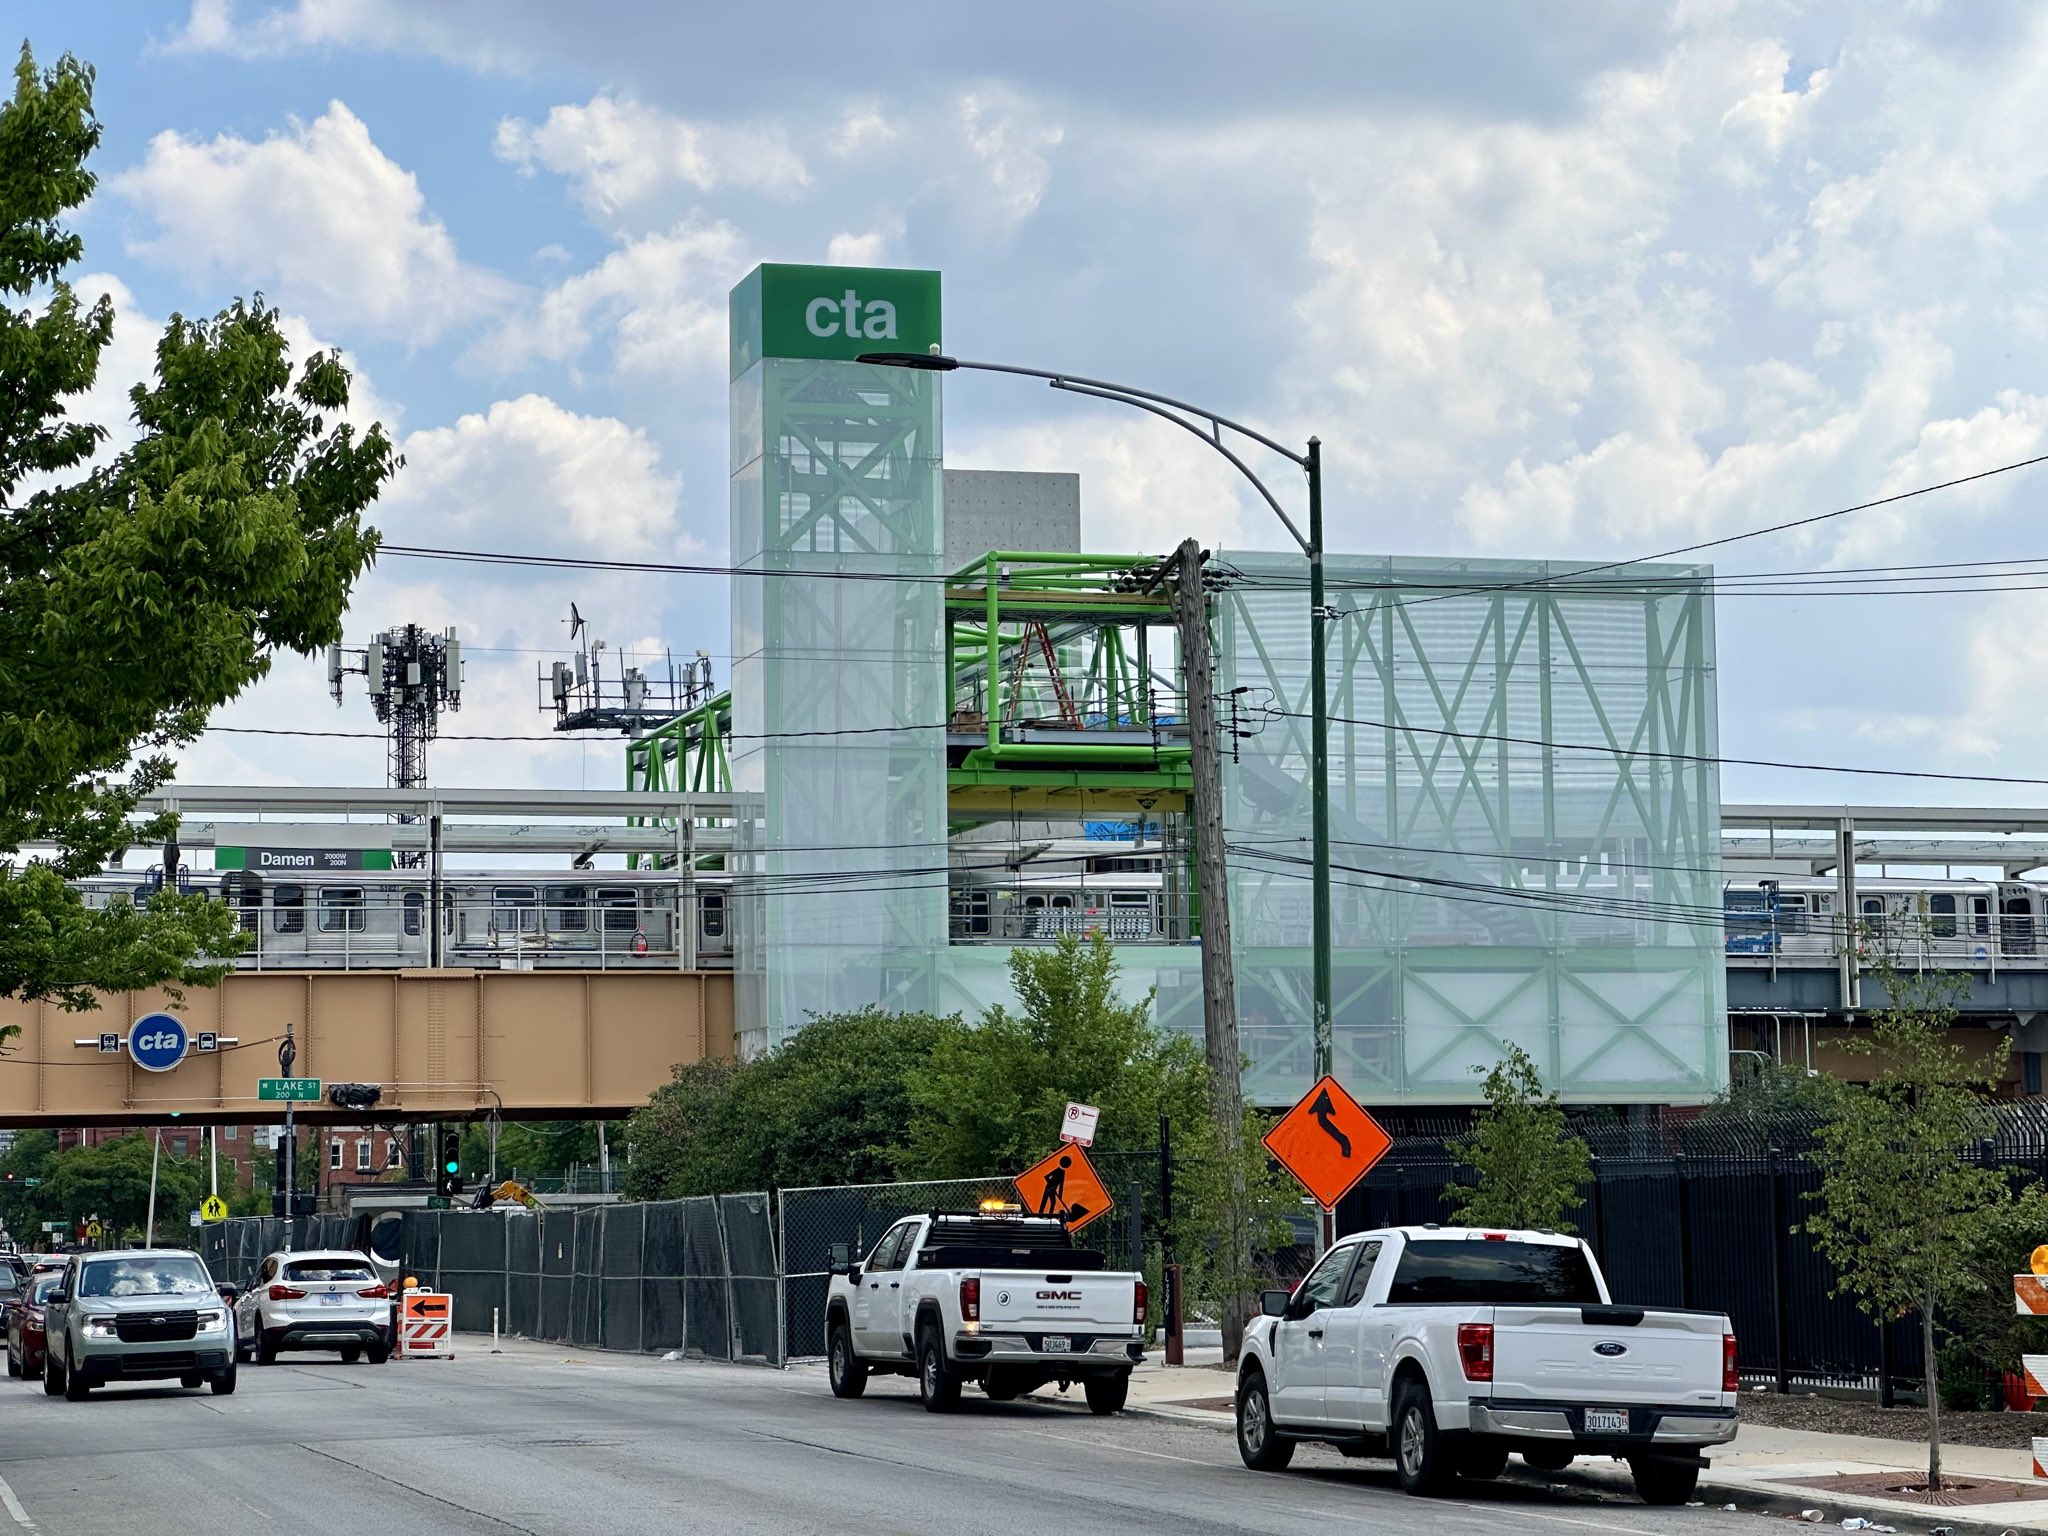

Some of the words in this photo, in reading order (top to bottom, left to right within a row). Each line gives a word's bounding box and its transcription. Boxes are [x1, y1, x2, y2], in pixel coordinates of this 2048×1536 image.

[805, 289, 898, 339] cta
[261, 852, 315, 866] Damen
[138, 1031, 179, 1051] cta
[275, 1081, 304, 1091] LAKE
[275, 1091, 290, 1099] 200
[1036, 1291, 1082, 1300] GMC
